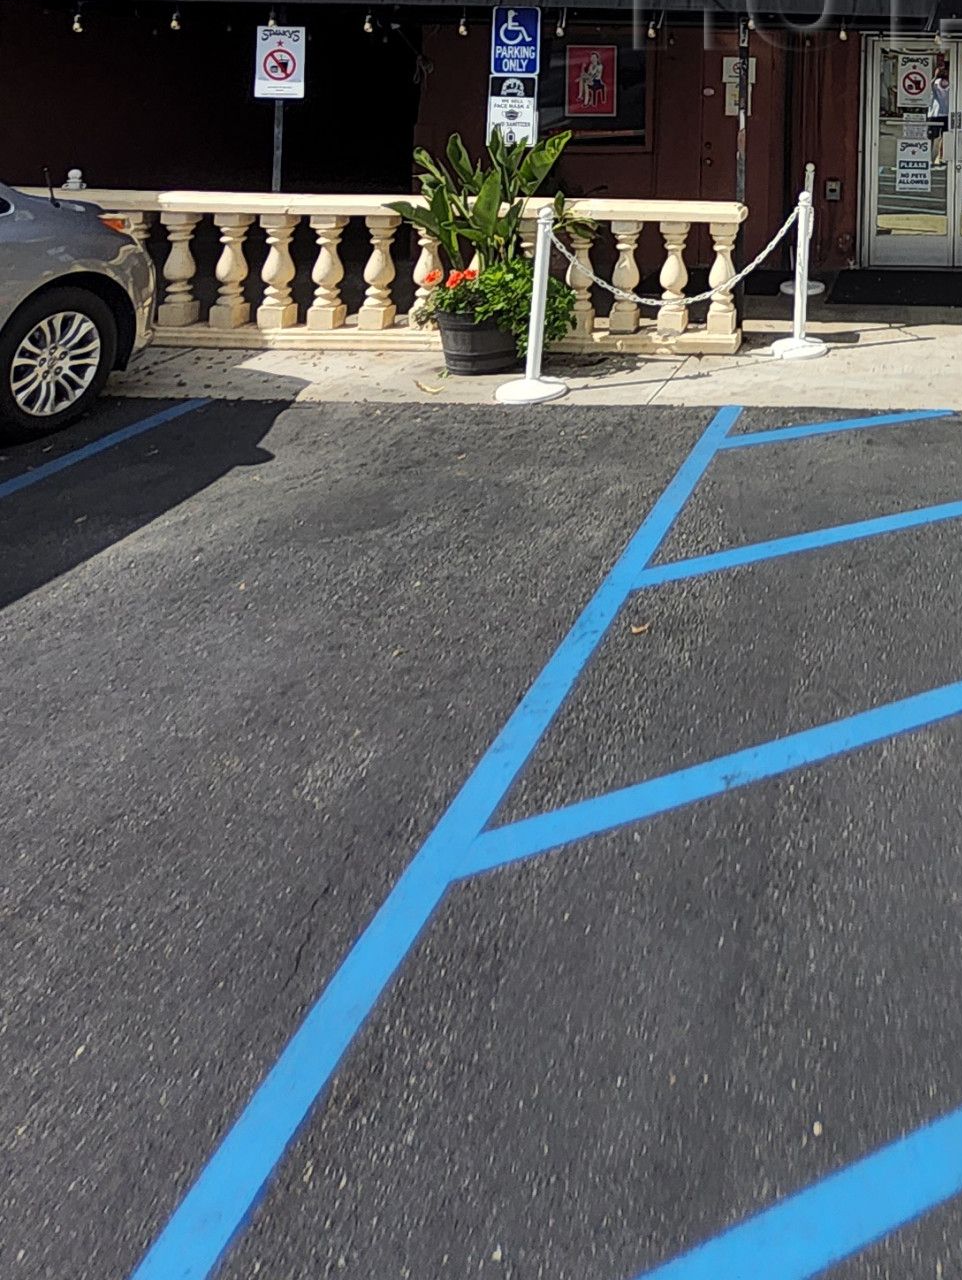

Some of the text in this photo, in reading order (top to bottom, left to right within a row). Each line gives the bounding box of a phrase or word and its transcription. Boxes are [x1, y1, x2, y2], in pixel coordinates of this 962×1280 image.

[495, 45, 536, 59] PARKING
[501, 59, 529, 72] ONLY
[900, 162, 928, 170] PLEASE
